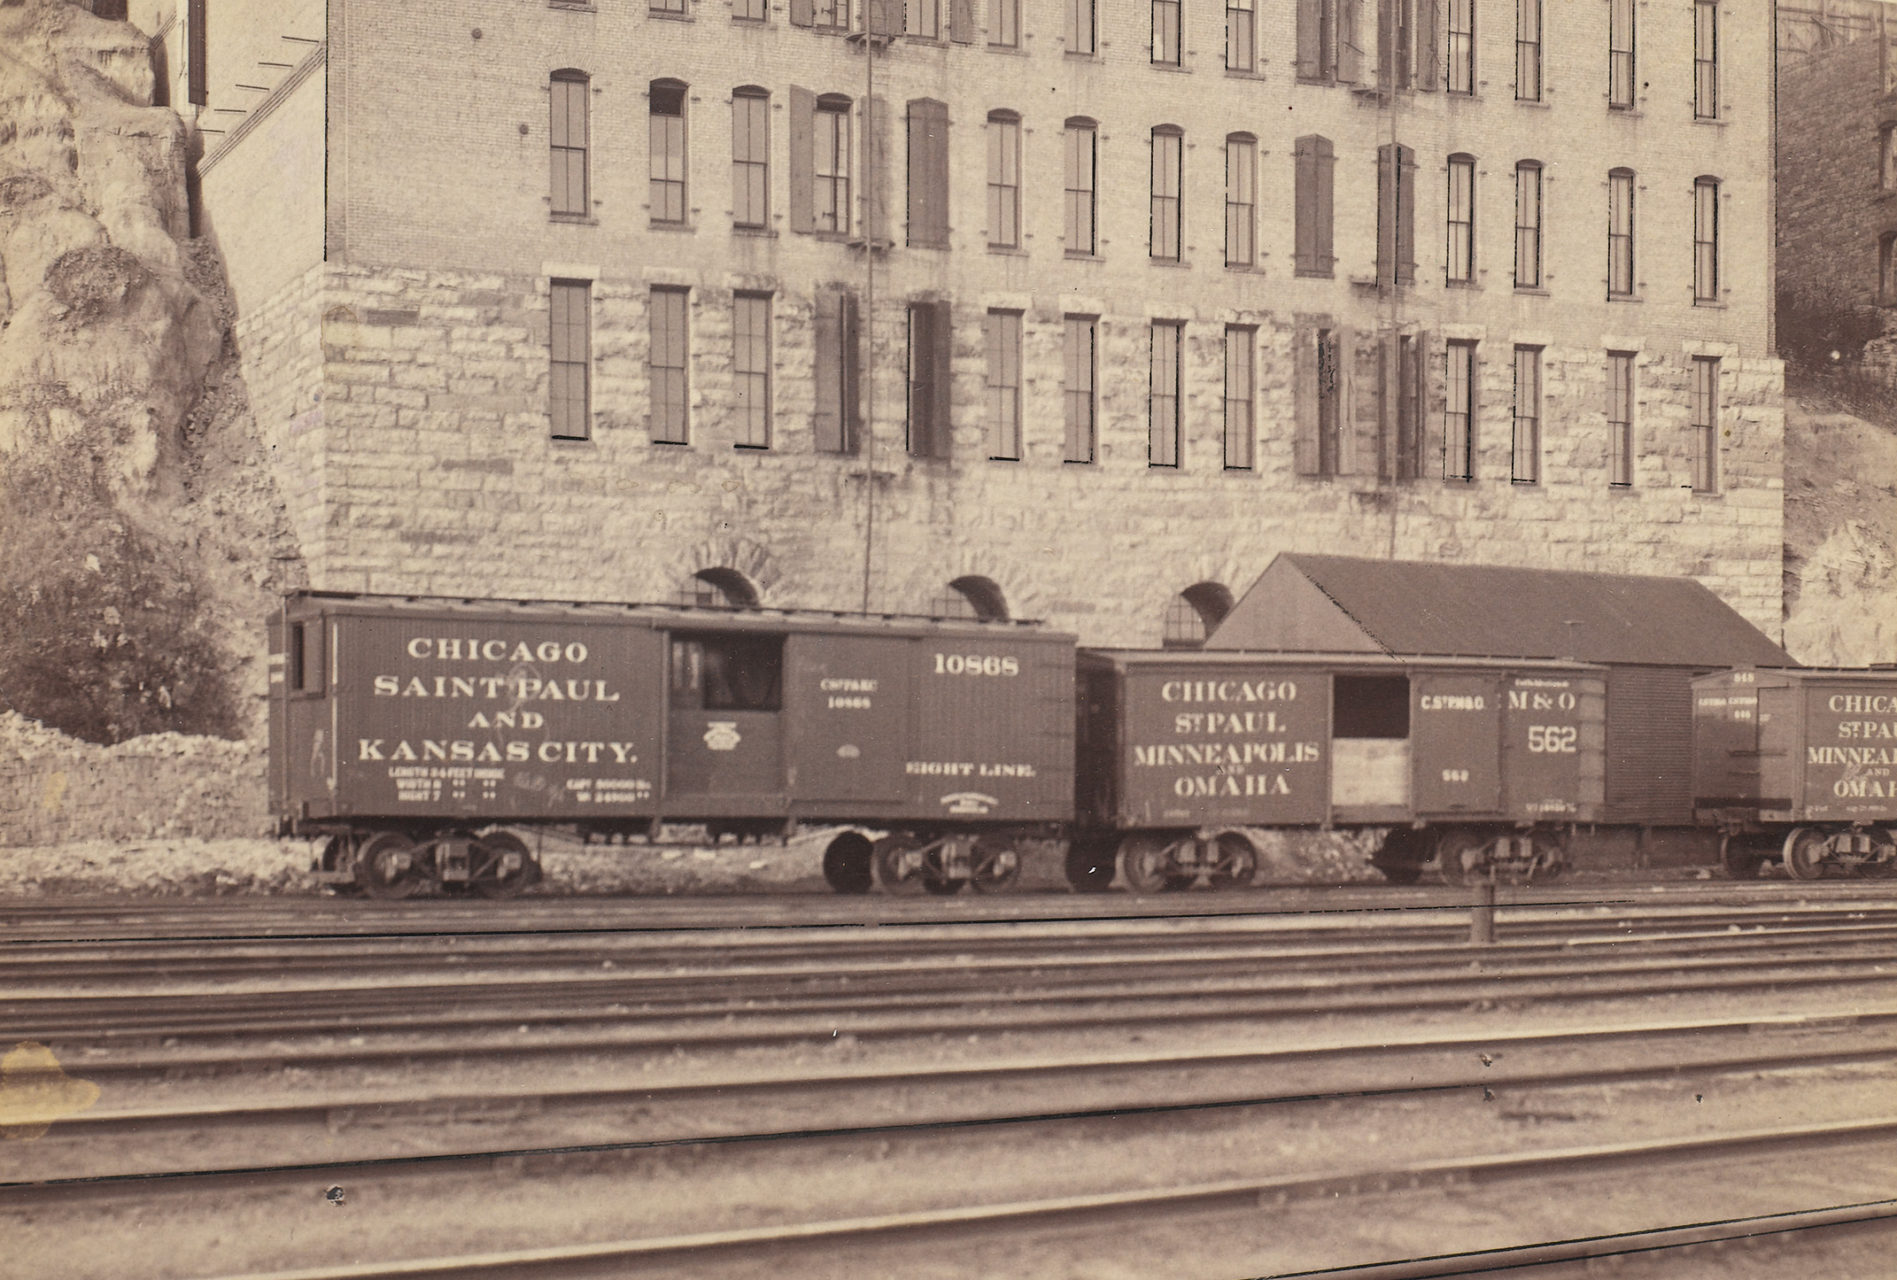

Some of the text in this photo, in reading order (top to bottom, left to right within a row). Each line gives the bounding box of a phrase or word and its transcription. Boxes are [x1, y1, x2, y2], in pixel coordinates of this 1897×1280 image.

[407, 637, 588, 663] CHICAGO
[934, 653, 1019, 676] 10868
[374, 675, 620, 702] SAINT PAUL
[1161, 681, 1297, 702] CHICAGO
[1509, 690, 1576, 710] M & O
[468, 711, 543, 729] AND
[1207, 711, 1286, 734] PAUL
[1528, 725, 1577, 752] 562
[358, 738, 638, 764] KANSAS CITY.
[1134, 742, 1320, 766] MINNEAPOLIS
[1865, 767, 1890, 777] AND
[1174, 774, 1291, 796] OMAHA
